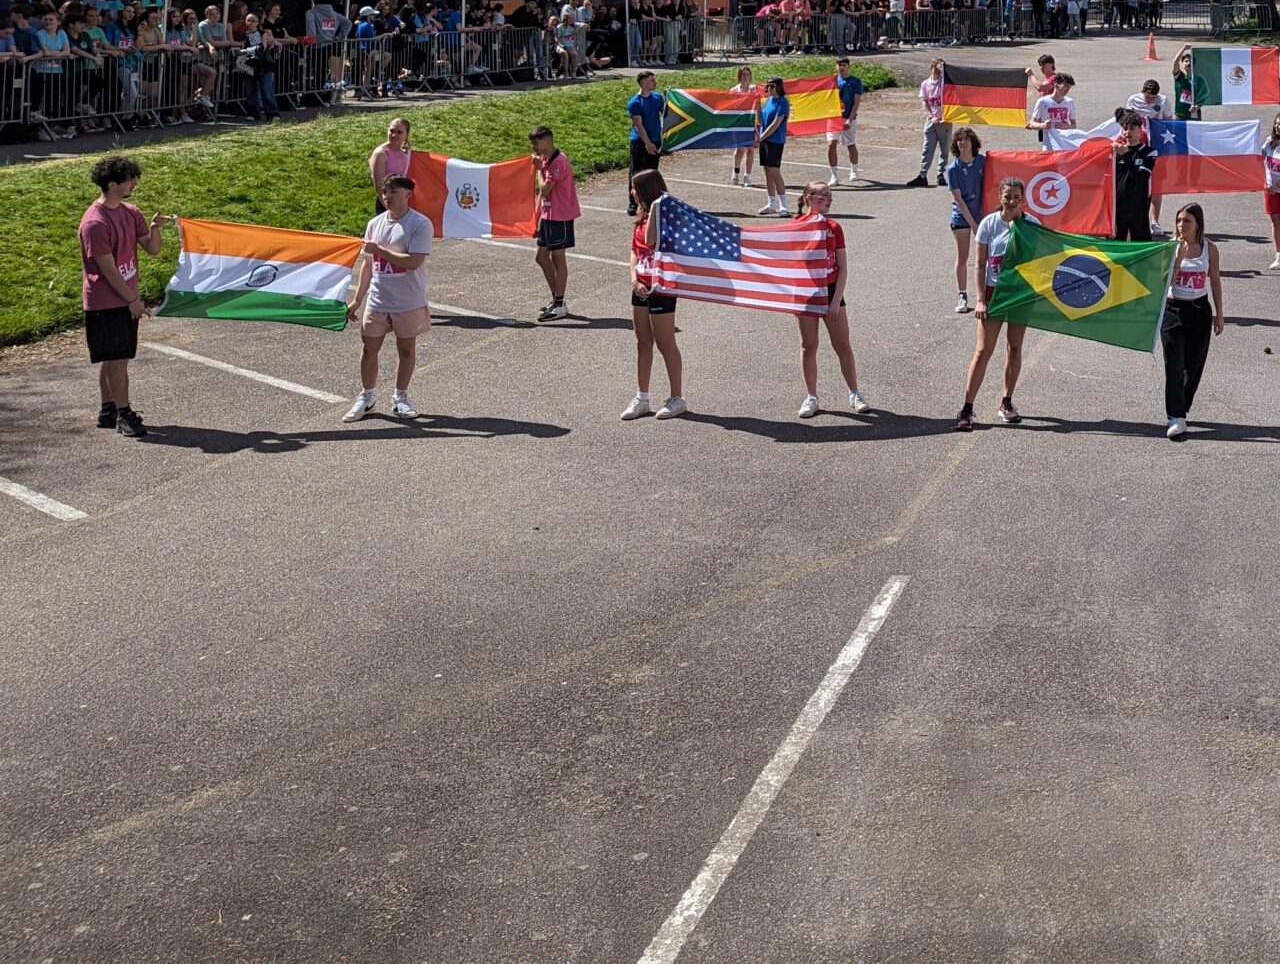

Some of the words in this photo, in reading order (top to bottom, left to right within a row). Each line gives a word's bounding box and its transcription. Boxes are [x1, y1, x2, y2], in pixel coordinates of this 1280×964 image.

[1047, 112, 1062, 121] ELA
[118, 258, 135, 274] ELA
[373, 261, 394, 273] ELA
[1175, 276, 1194, 288] ELA
